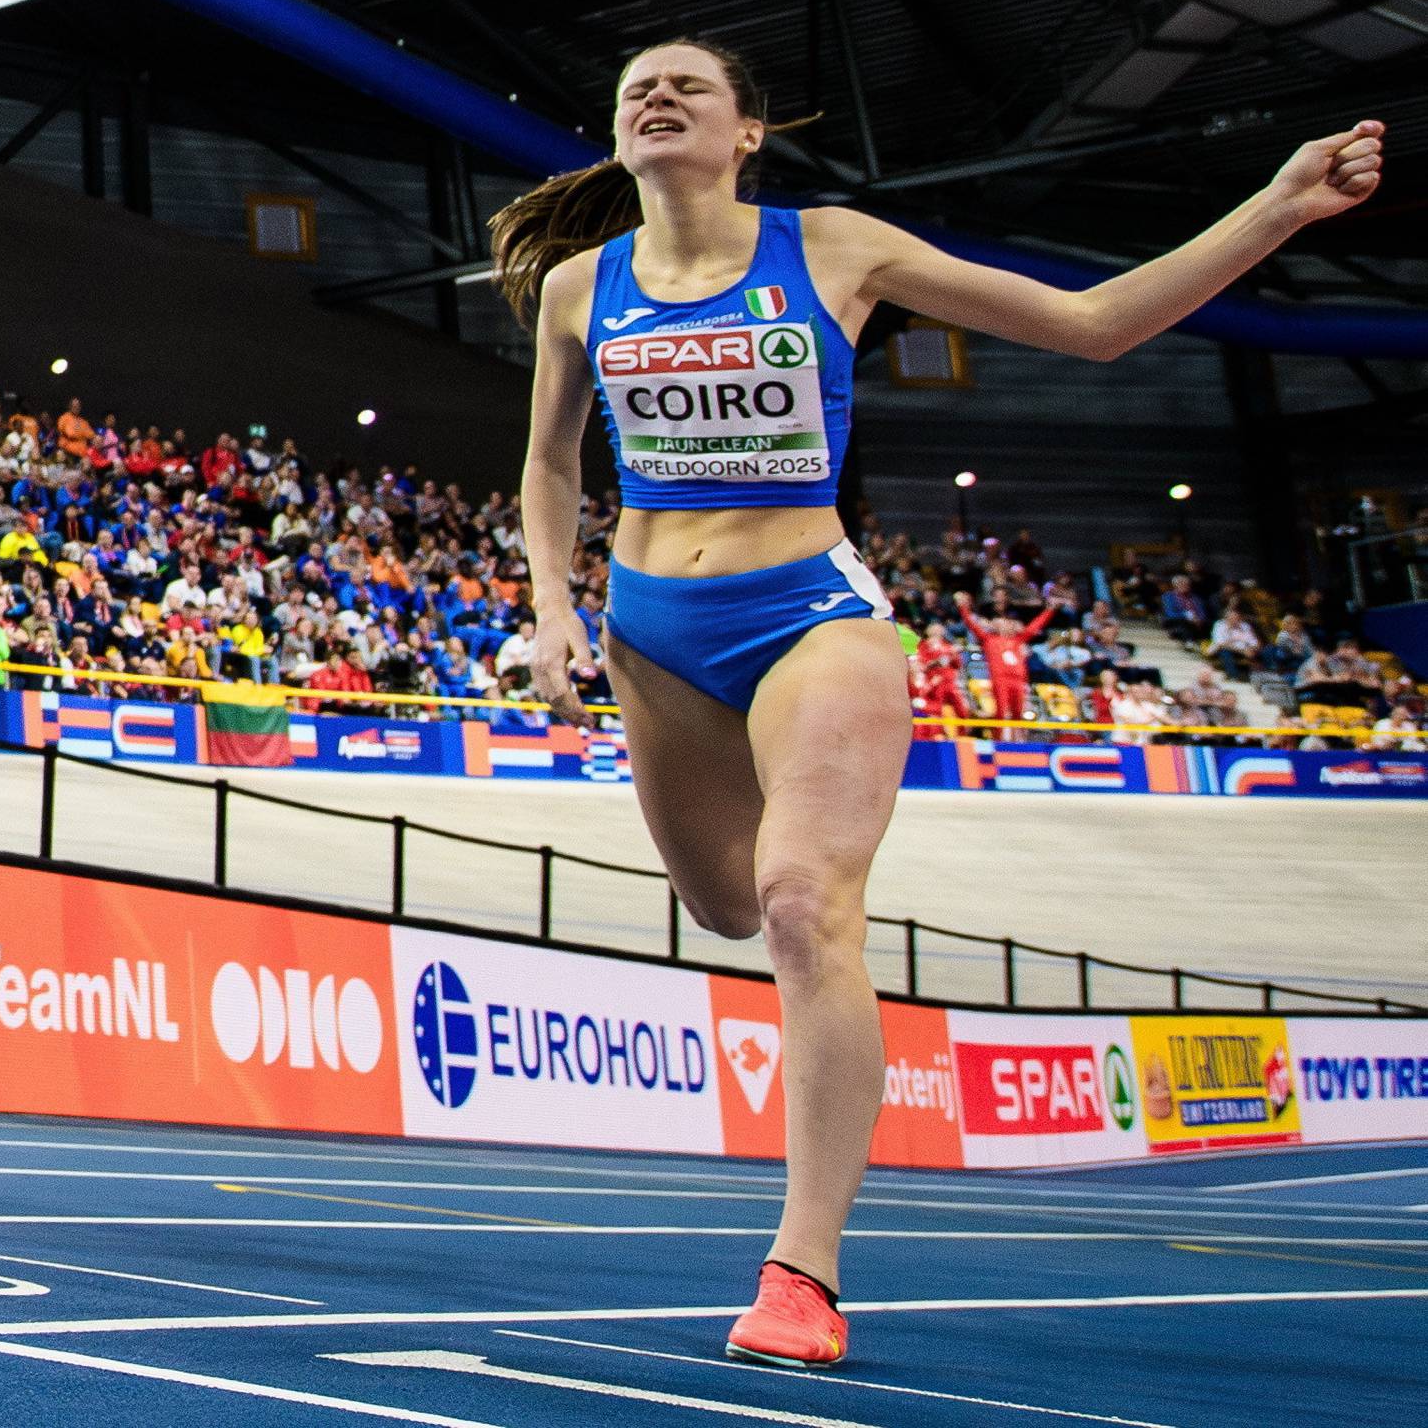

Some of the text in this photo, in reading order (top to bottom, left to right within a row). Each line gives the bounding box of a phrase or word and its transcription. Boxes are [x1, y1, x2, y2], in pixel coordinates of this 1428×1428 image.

[604, 336, 751, 371] SPAR
[626, 380, 795, 422] COIRO
[706, 436, 773, 452] CLEAN
[631, 457, 822, 476] APELDOORN 2025
[487, 1004, 706, 1095] EUROHOLD
[881, 1051, 955, 1122] oterij
[990, 1057, 1104, 1122] SPAR
[1299, 1056, 1370, 1101] TOYO
